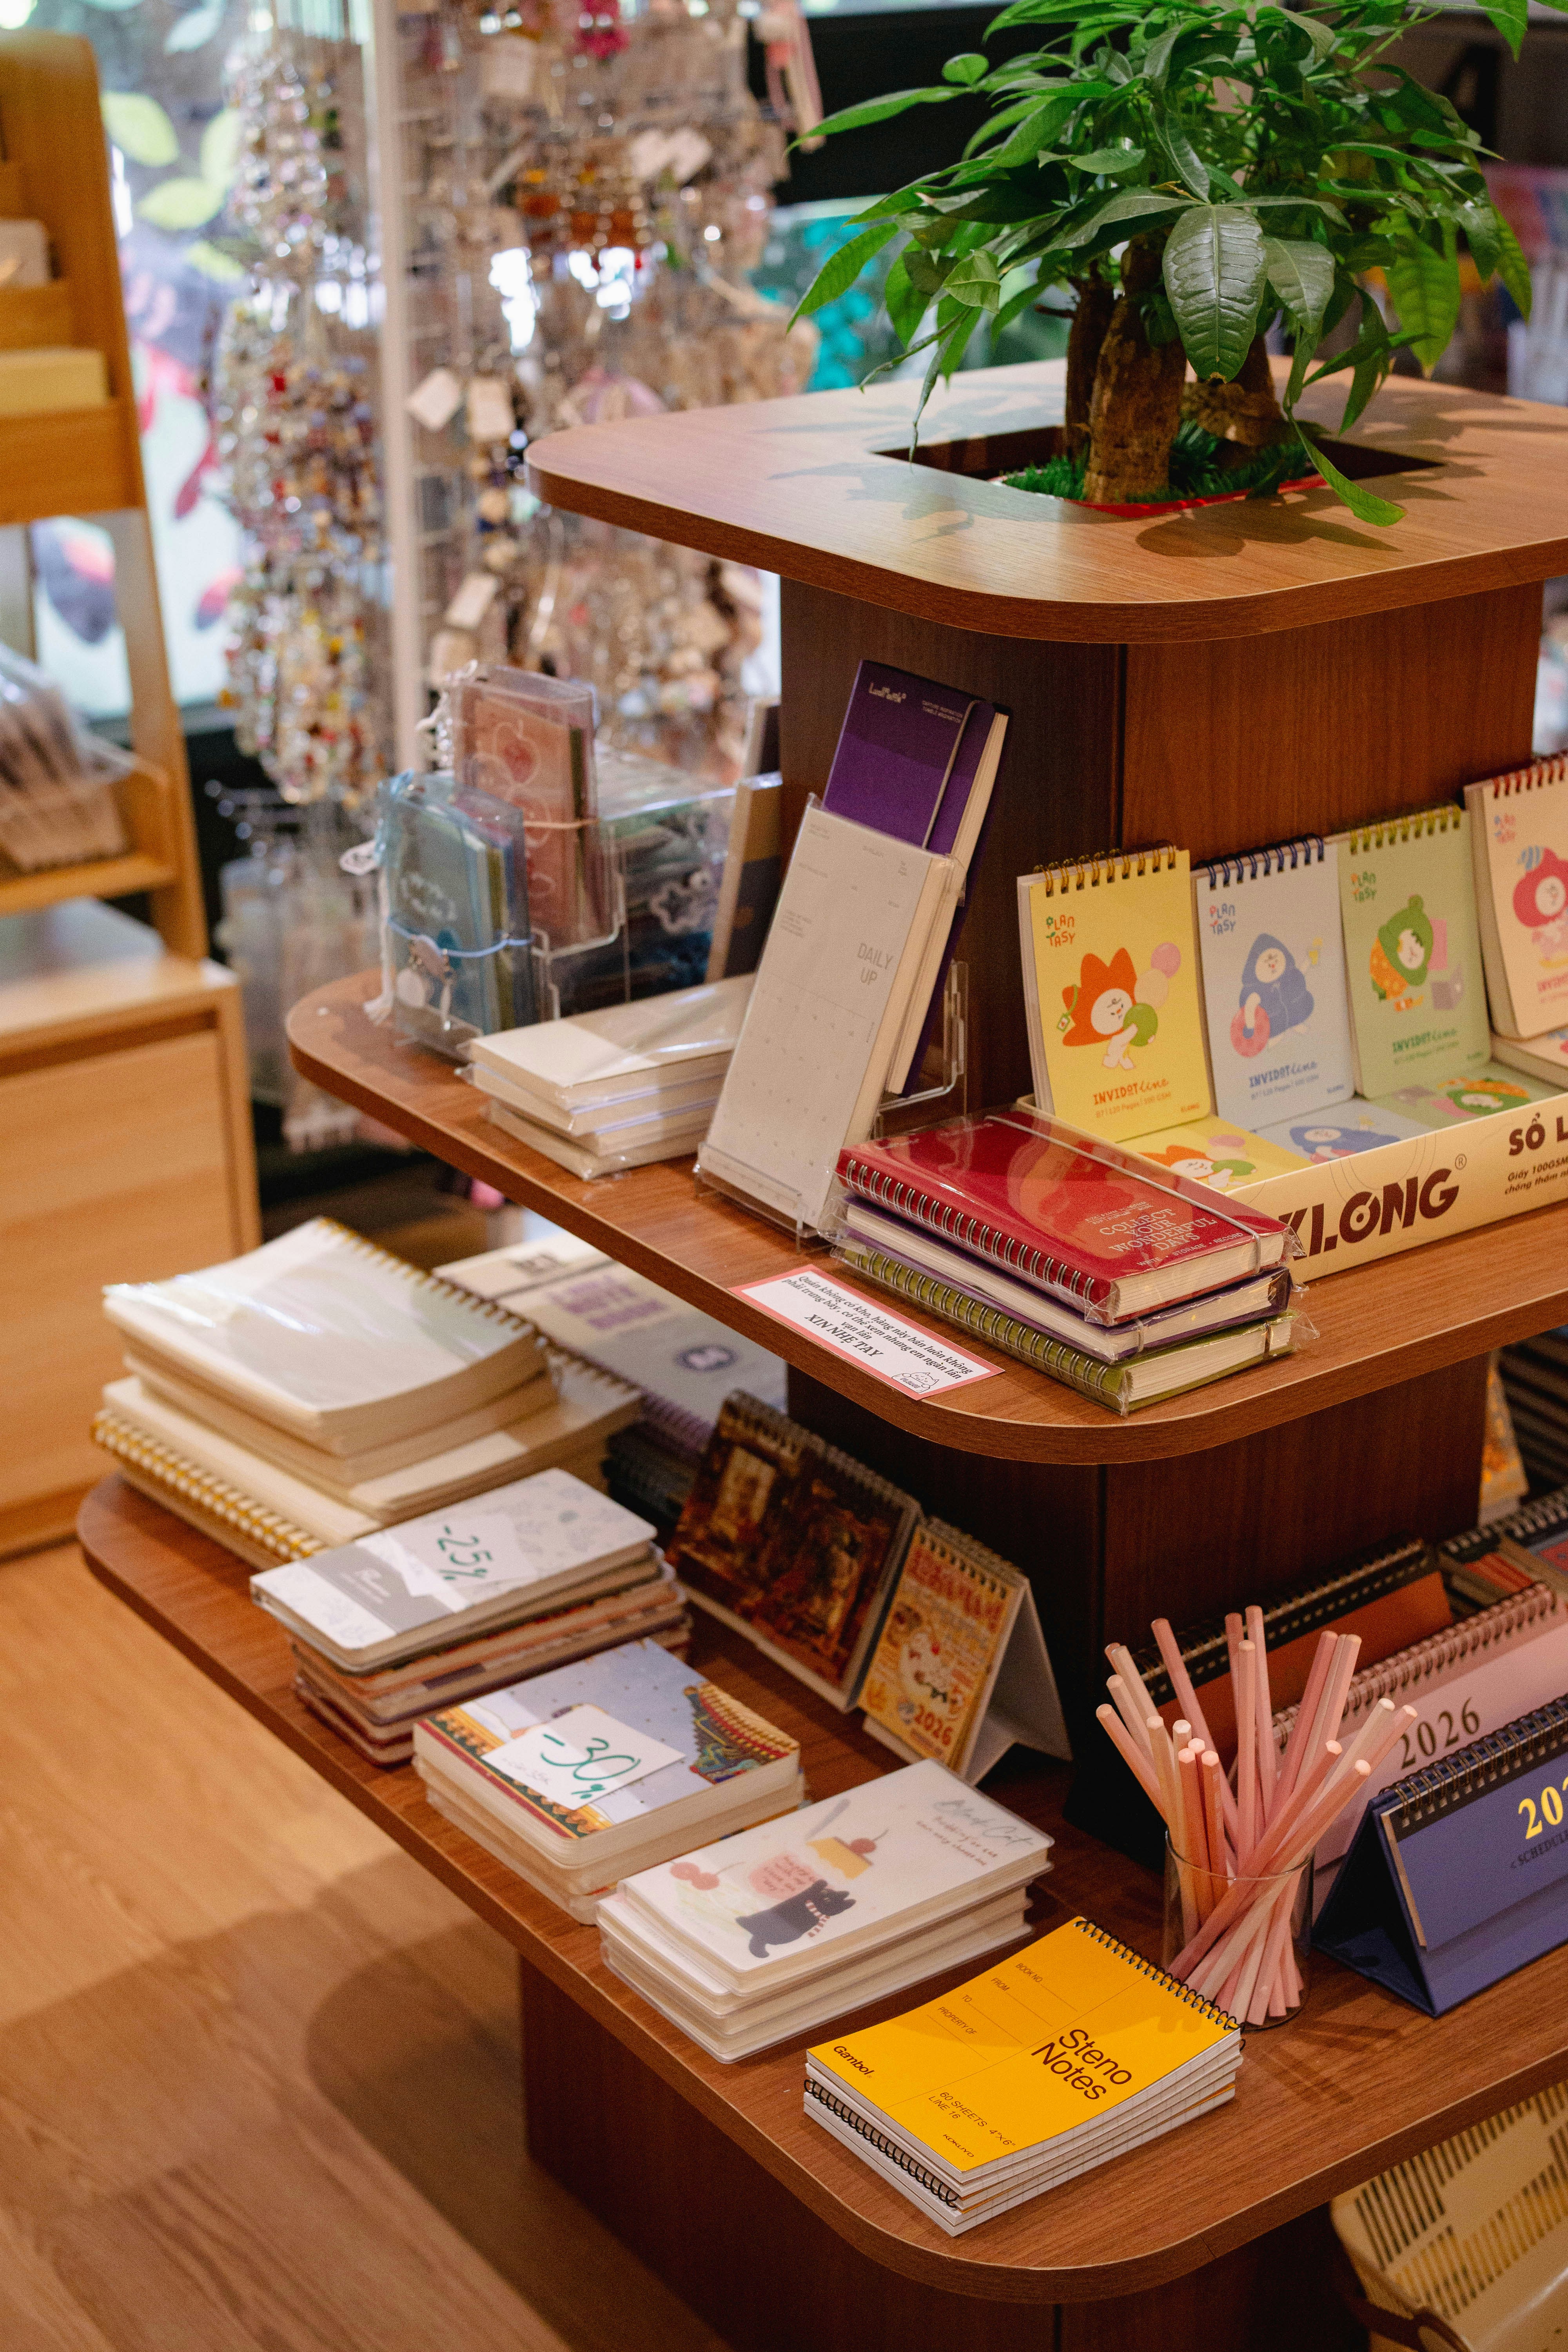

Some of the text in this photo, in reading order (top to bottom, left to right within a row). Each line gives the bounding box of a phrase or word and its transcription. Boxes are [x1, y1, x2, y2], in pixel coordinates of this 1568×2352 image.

[1046, 914, 1074, 930] PLAN
[1046, 931, 1075, 947] TASY
[857, 942, 894, 970] DAILY
[860, 968, 878, 985] UP
[1100, 1208, 1176, 1235] COLLECT
[1108, 1218, 1218, 1252] WONDERFUL
[1124, 1219, 1176, 1238] YOUR
[1137, 1232, 1244, 1266] WRITE STORAGE RECORD
[1151, 1233, 1200, 1250] DAYS
[799, 1276, 821, 1289] Quán
[819, 1287, 846, 1303] không
[853, 1306, 871, 1318] kho,
[871, 1316, 895, 1330] hàng
[892, 1327, 911, 1341] này
[907, 1336, 926, 1348] bán
[924, 1345, 946, 1359] luôn
[943, 1357, 974, 1375] không
[804, 1314, 884, 1357] XIN NHẸ TAY
[840, 1321, 873, 1340] vạn lần
[864, 1325, 885, 1336] xem
[909, 1349, 926, 1359] em
[923, 1357, 947, 1371] ngàn
[944, 1368, 962, 1379] lần
[914, 1705, 953, 1746] 2026
[1401, 1697, 1480, 1770] 2026
[1016, 1963, 1033, 1976] BOOK
[991, 1978, 1010, 1991] FROM
[938, 2007, 969, 2028] PROPERTY
[834, 2046, 875, 2075] Gambol
[1059, 2029, 1132, 2085] Steno
[1031, 2042, 1107, 2100] Notes
[928, 2096, 960, 2119] LINE 16
[940, 2092, 953, 2101] 60
[951, 2101, 987, 2127] SHEETS
[943, 2134, 974, 2158] KOKUYO
